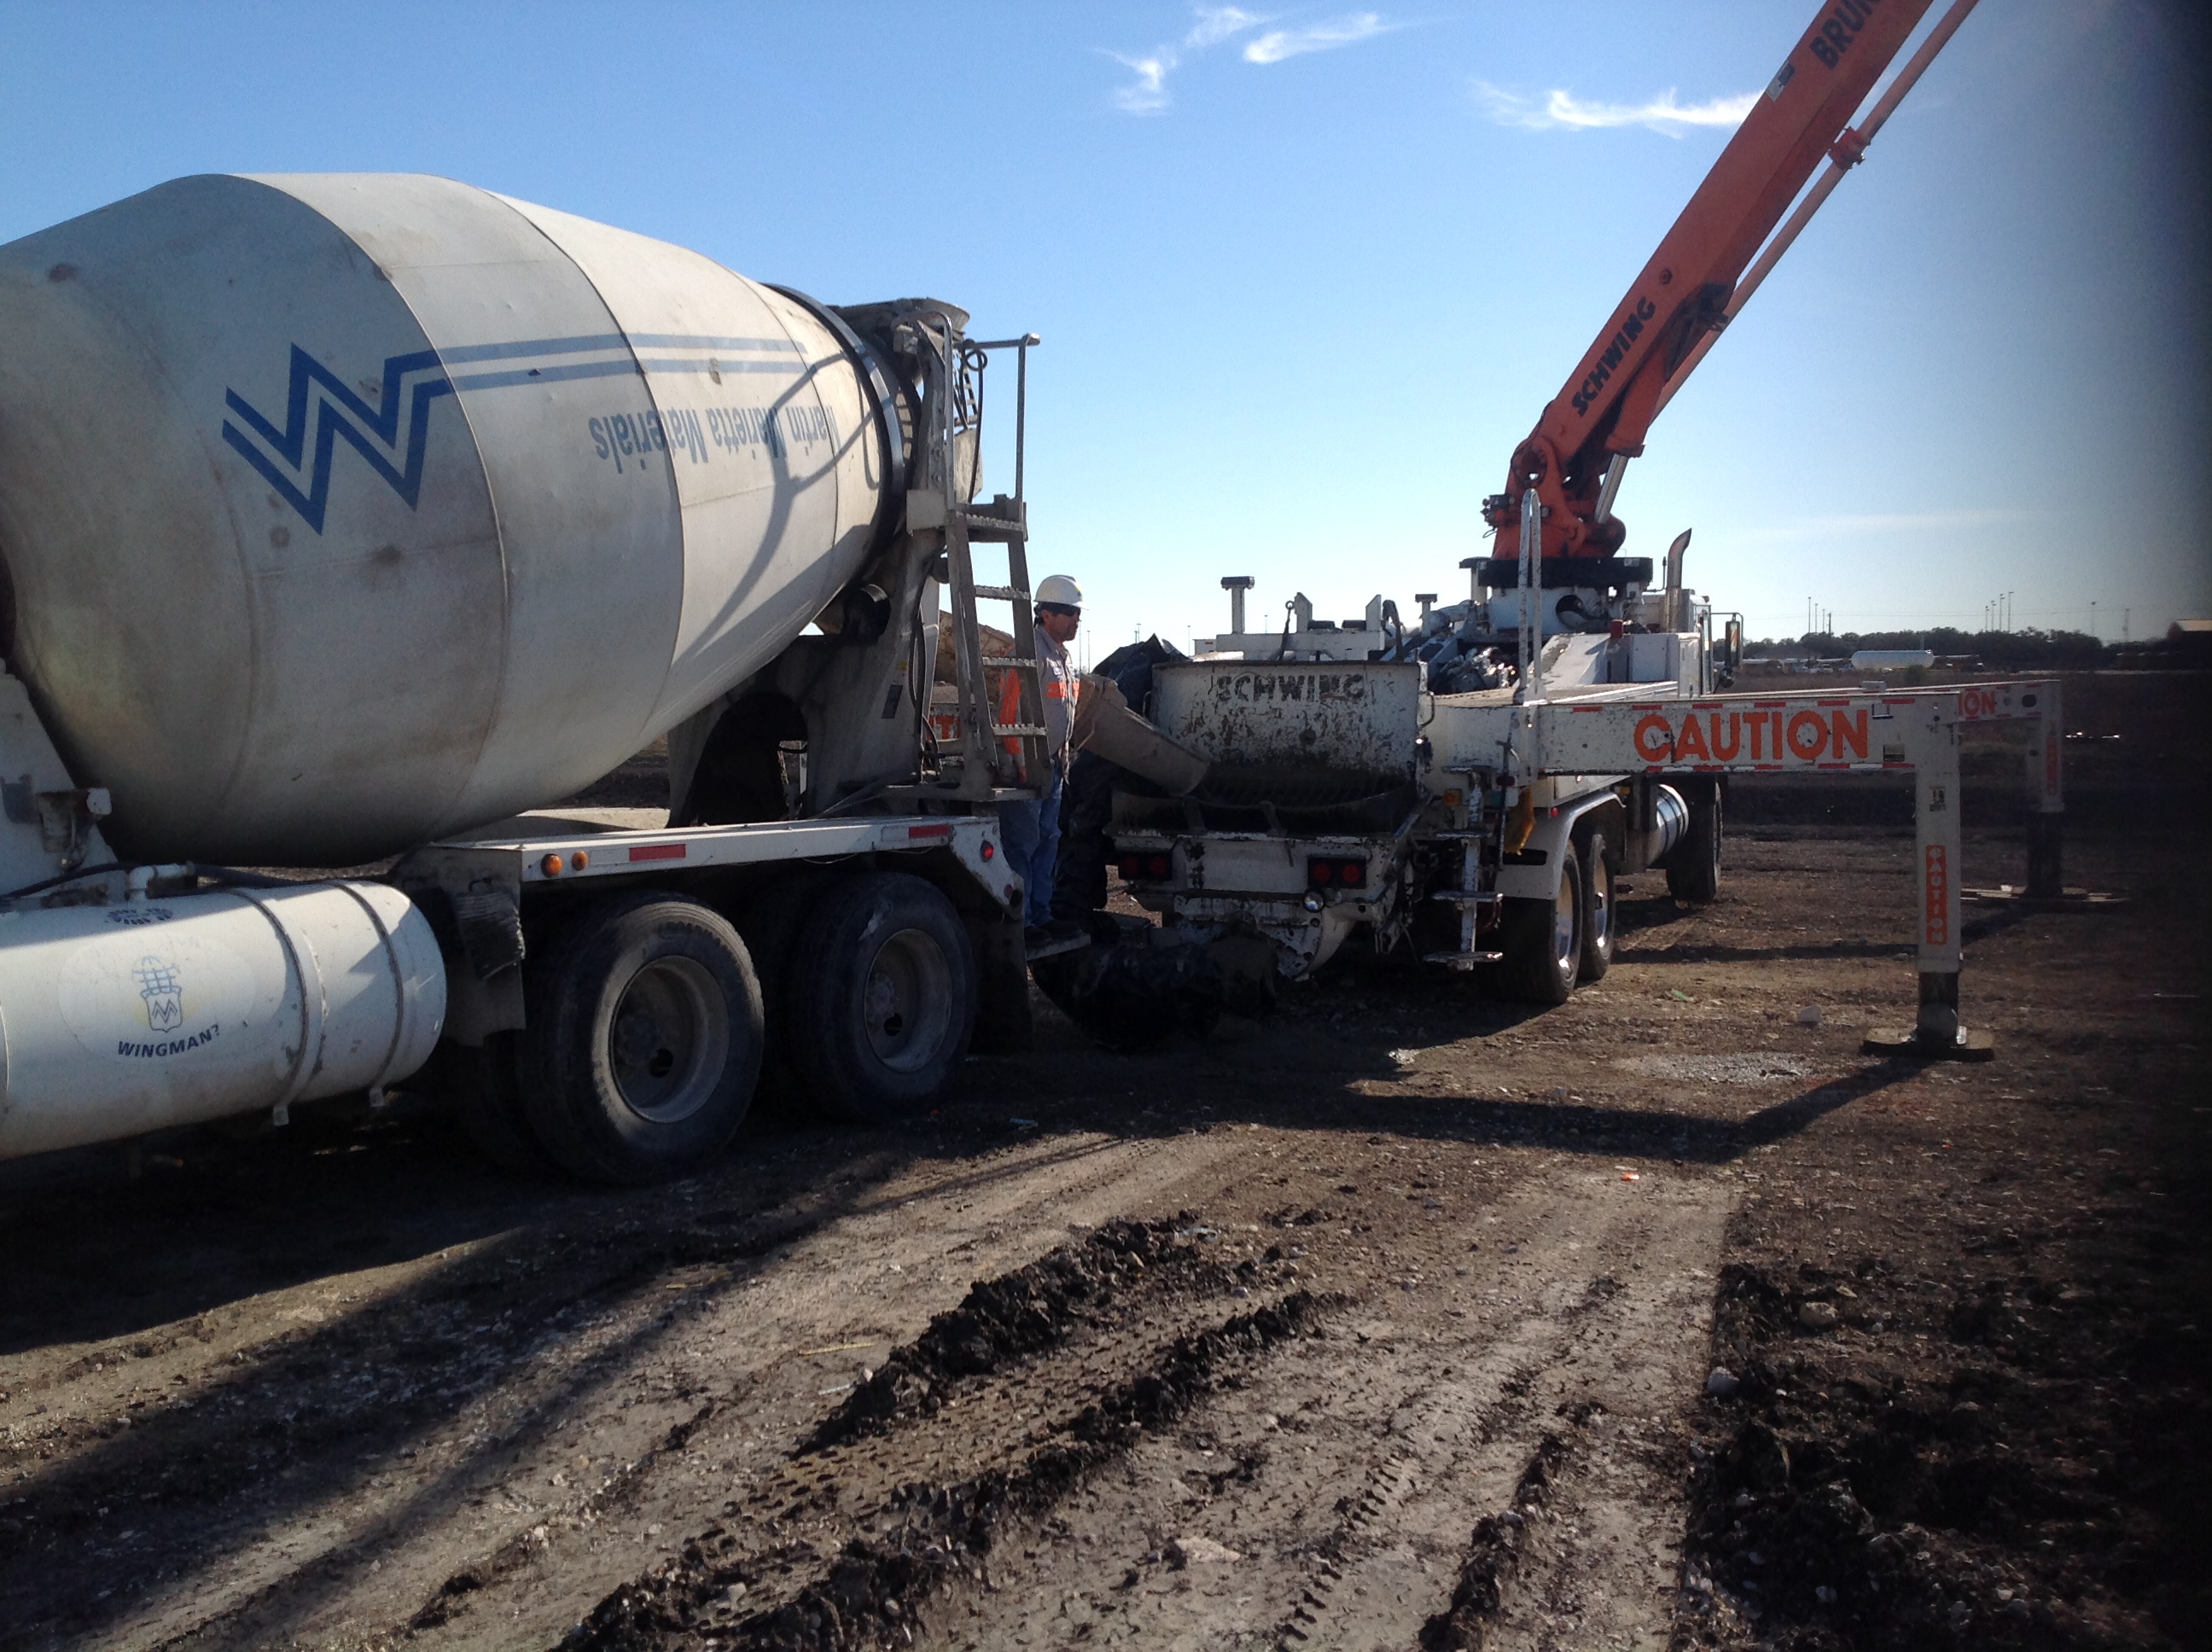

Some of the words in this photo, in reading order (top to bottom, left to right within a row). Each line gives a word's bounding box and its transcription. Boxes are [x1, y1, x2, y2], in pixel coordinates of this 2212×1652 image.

[1571, 295, 1656, 417] SCHWING
[588, 406, 708, 474] Materials
[705, 406, 788, 459] Marietta
[785, 405, 841, 457] Martin
[1216, 673, 1365, 702] SCHWING
[1633, 710, 1869, 763] CAUTION
